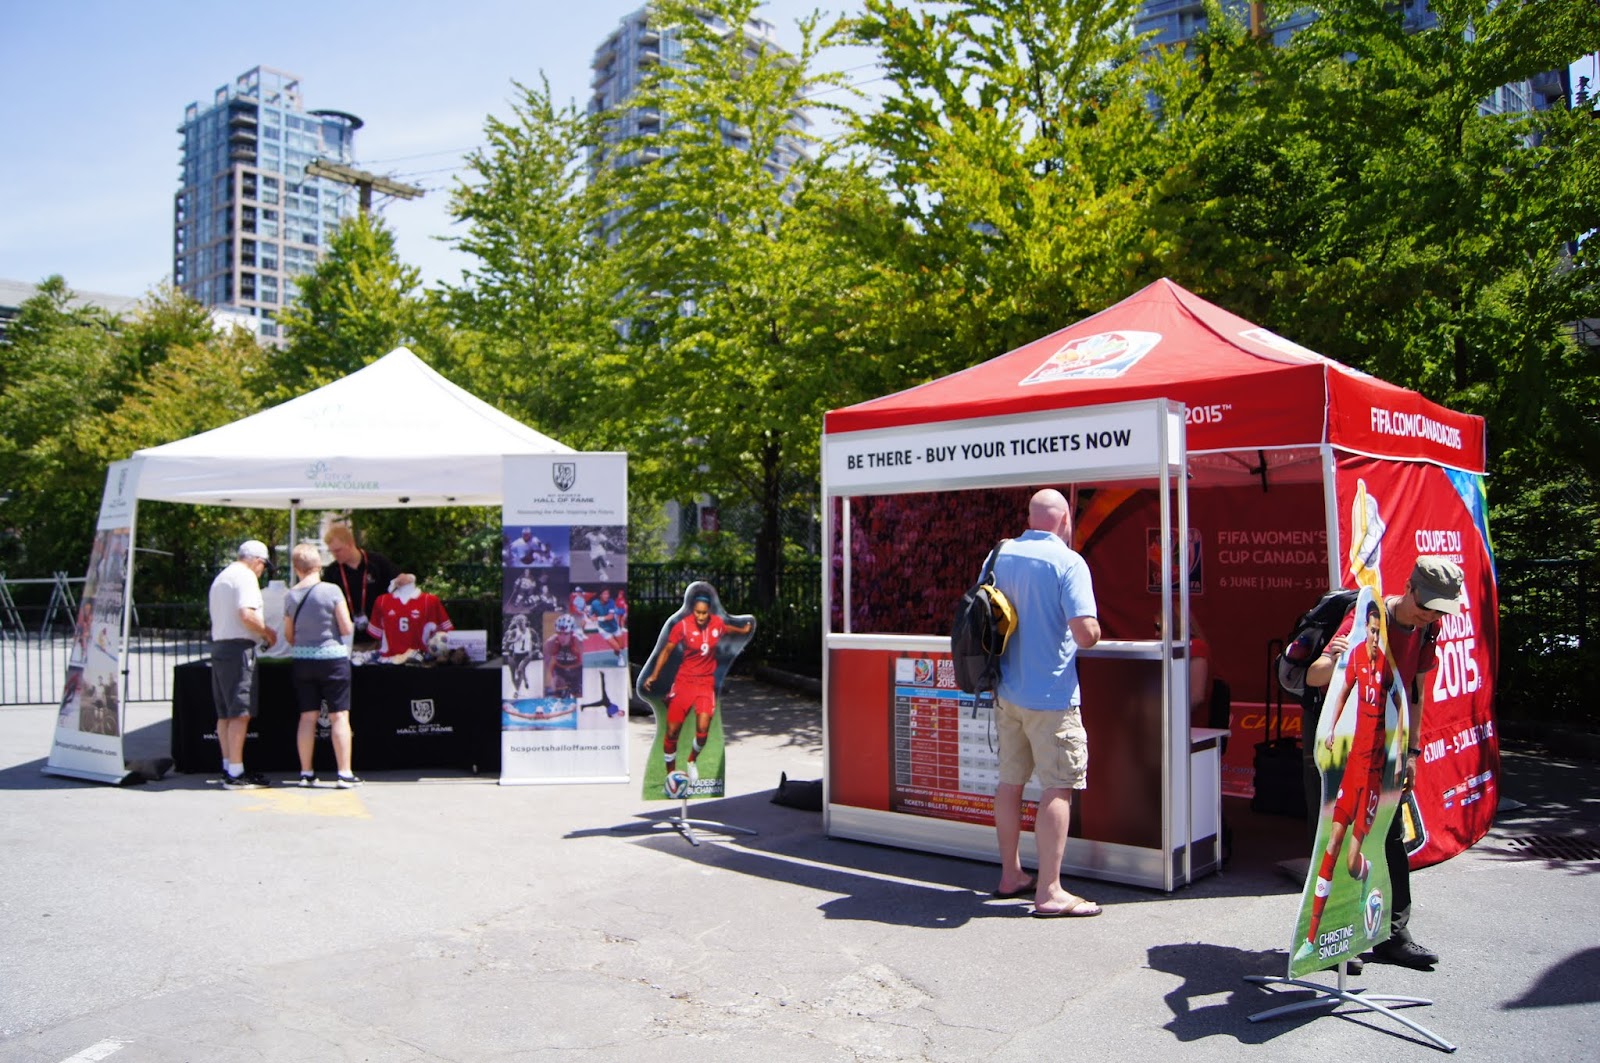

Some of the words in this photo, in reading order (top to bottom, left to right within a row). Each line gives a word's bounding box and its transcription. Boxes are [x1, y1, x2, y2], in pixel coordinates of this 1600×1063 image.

[1370, 406, 1462, 450] FIFA.COM/CANADA2015
[847, 455, 864, 469] BE
[867, 449, 912, 468] THERE
[925, 446, 957, 463] BUY
[961, 441, 1006, 460] YOUR
[1009, 434, 1081, 456] TICKETS
[1085, 429, 1132, 449] NOW
[314, 481, 380, 490] VANCOUVER
[1218, 531, 1249, 545] FIFA
[1415, 530, 1448, 553] COUPE
[1447, 530, 1461, 552] DU
[1218, 551, 1250, 564] CUP
[1252, 551, 1318, 565] CANADA
[1219, 577, 1227, 588] 6
[1229, 576, 1258, 588] JUNE
[1267, 577, 1293, 589] JUIN
[1304, 579, 1312, 589] 5
[399, 616, 409, 632] 6
[1437, 611, 1474, 642] ANADA
[700, 642, 710, 656] 9
[937, 659, 954, 668] FIFA
[1433, 637, 1480, 703] 2015
[937, 679, 956, 688] 2015
[1365, 684, 1376, 706] 12
[510, 743, 620, 754] bcsportshalloffame.com
[1453, 735, 1460, 754] 5
[904, 798, 924, 807] TICKETS
[928, 802, 948, 810] BILLETS
[952, 805, 995, 816] FIFA.COM/CANAD
[1366, 790, 1379, 816] 12
[1319, 924, 1354, 947] CHRISTINE
[1318, 939, 1349, 960] SINCLAIR
